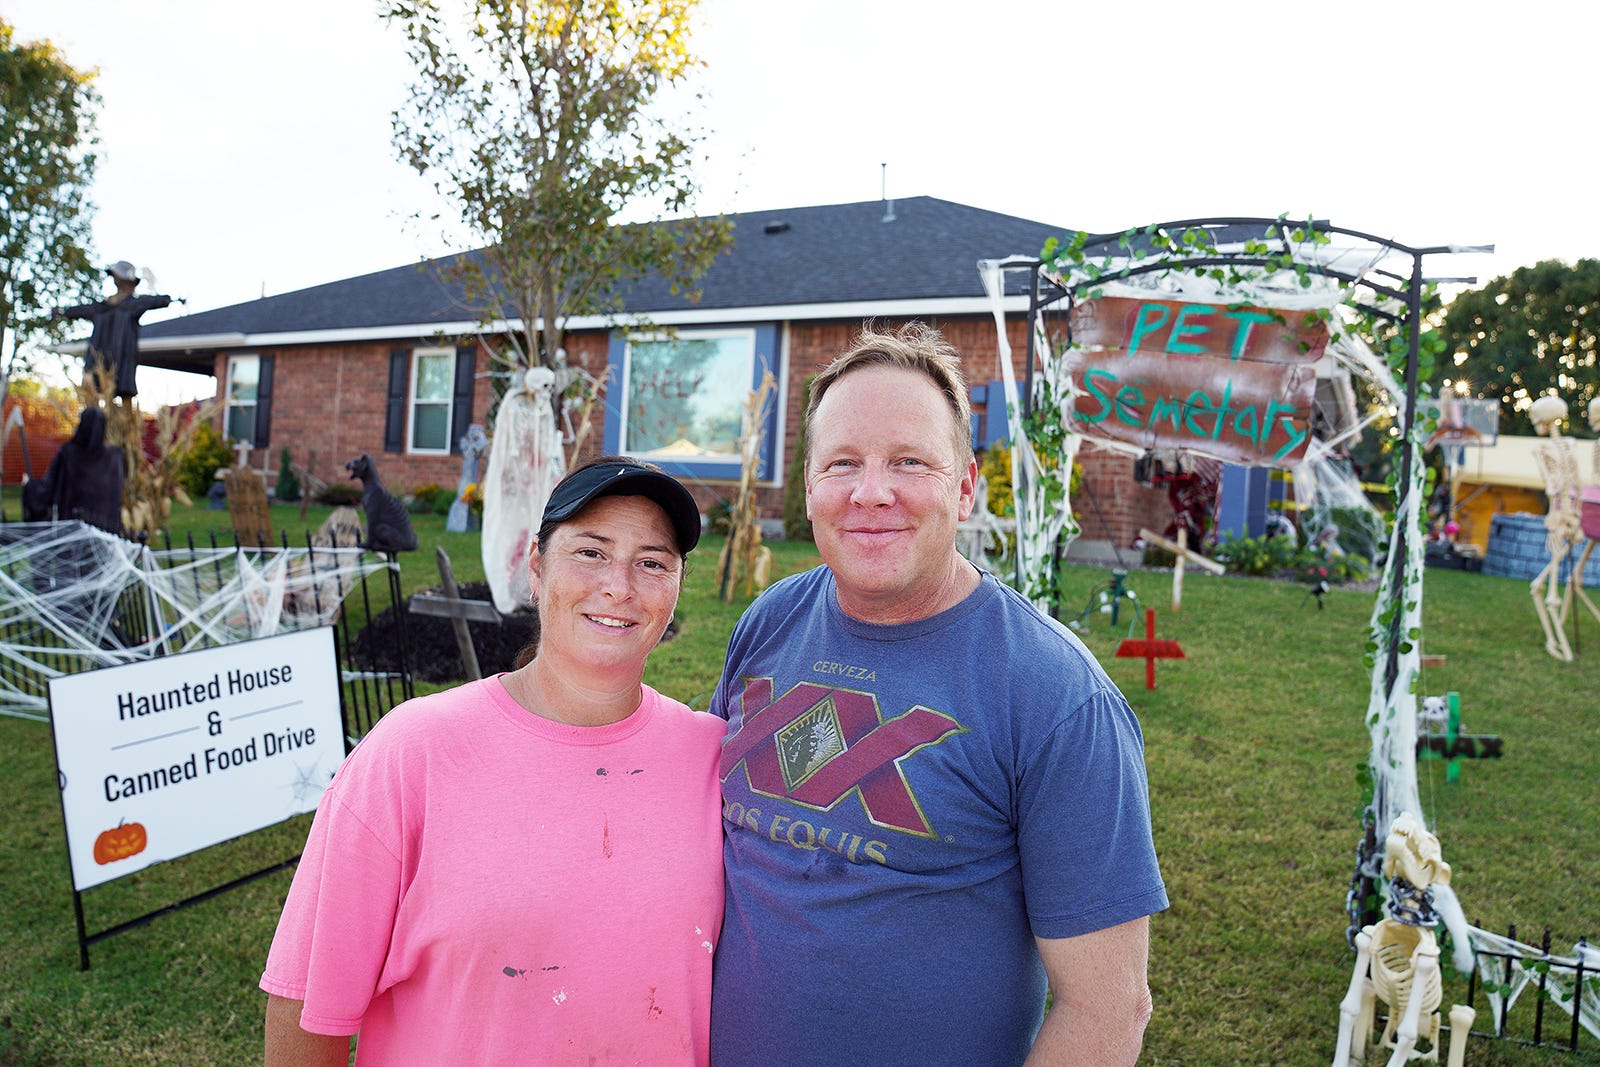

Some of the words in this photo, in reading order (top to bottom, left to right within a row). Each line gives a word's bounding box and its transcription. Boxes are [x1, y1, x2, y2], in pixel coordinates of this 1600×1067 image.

[1128, 303, 1276, 362] PET
[117, 674, 221, 721] Haunted
[228, 664, 292, 696] House
[813, 661, 876, 682] CERVEZA
[207, 711, 222, 736] &
[104, 754, 197, 802] Canned
[205, 737, 257, 774] Food
[264, 727, 316, 757] Drive
[769, 814, 888, 865] EQUIS
